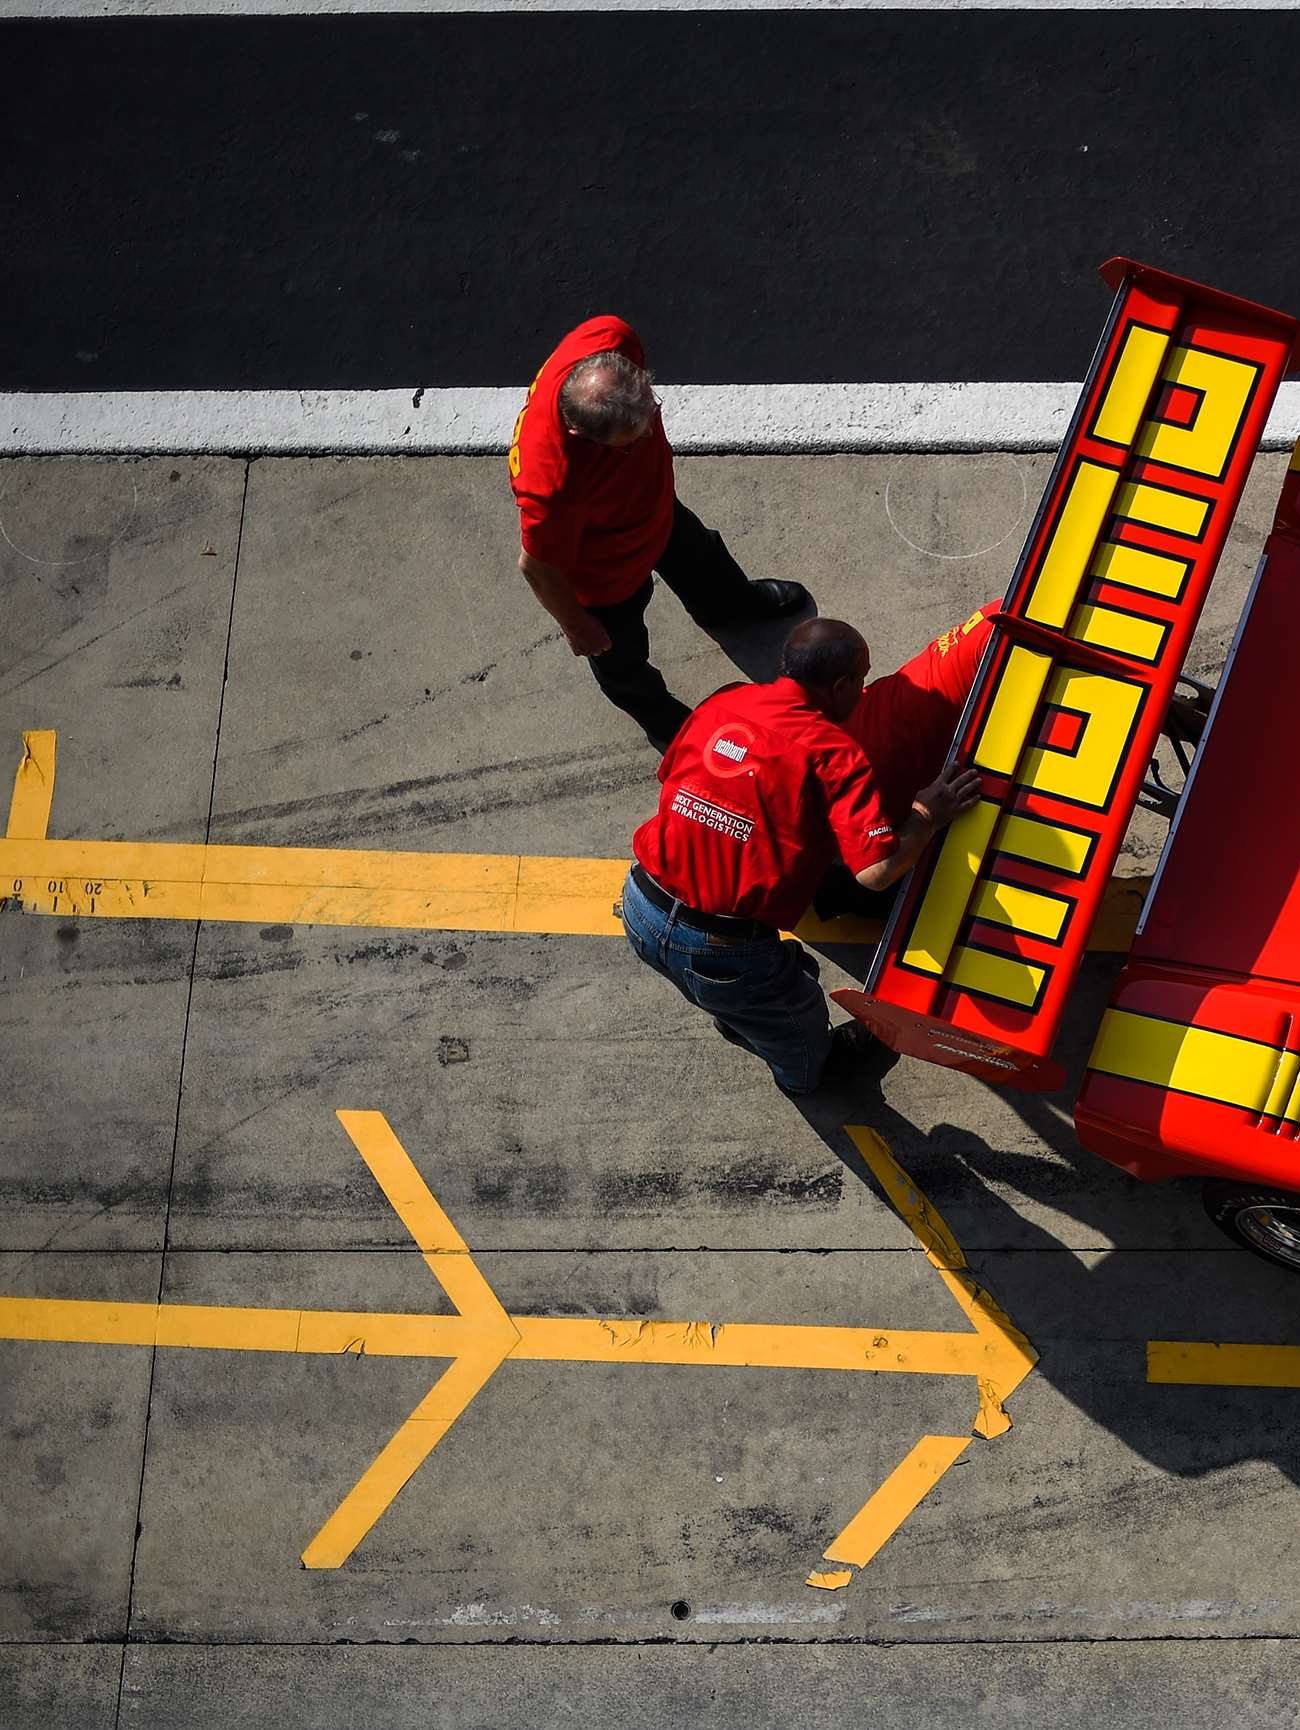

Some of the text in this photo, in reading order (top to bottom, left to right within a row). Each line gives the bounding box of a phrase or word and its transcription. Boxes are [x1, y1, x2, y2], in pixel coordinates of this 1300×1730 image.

[671, 802, 749, 842] INTRALOGISTICS
[674, 794, 692, 807] NEXT
[692, 802, 752, 834] GENERATION
